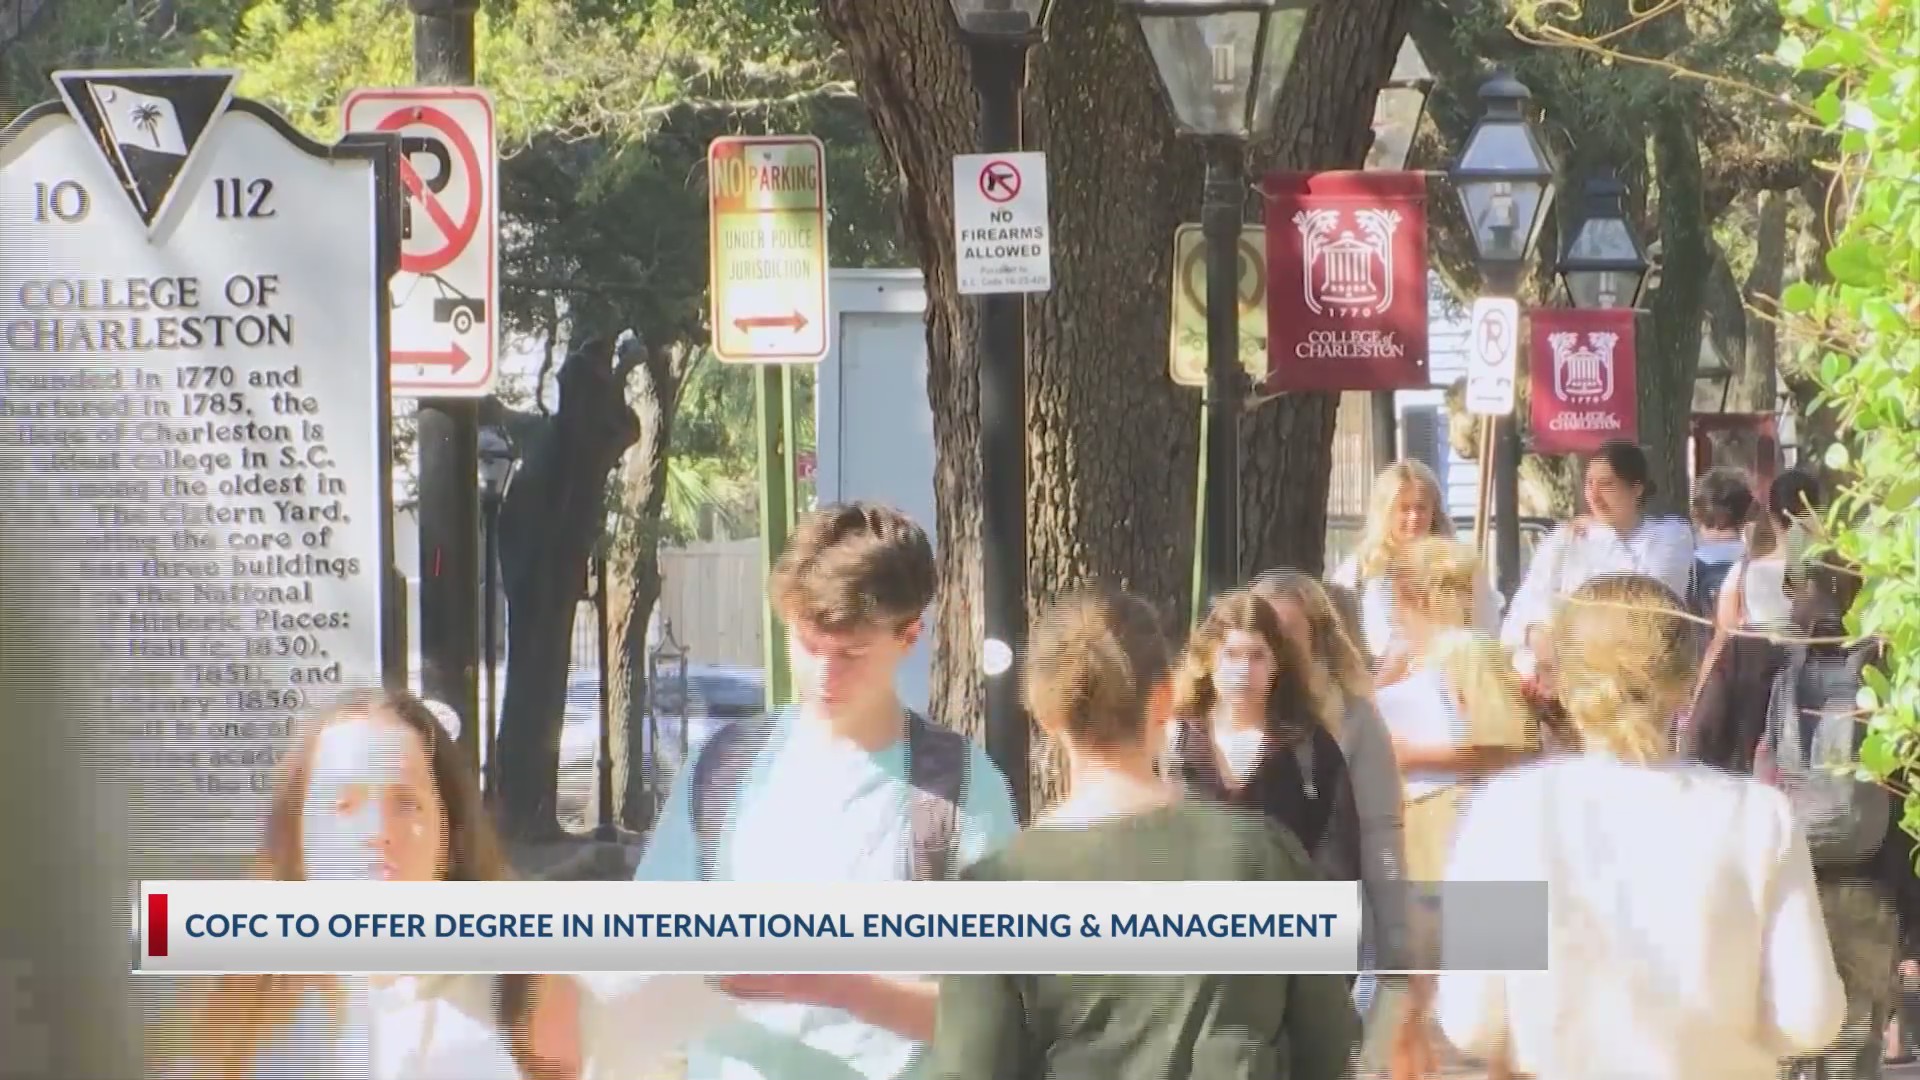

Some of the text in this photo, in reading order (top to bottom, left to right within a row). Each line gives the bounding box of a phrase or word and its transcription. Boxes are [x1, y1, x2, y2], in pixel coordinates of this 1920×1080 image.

[713, 156, 817, 199] NO PARKING
[33, 181, 89, 223] 10
[214, 178, 277, 219] 112
[990, 210, 1013, 223] NO
[725, 228, 812, 249] UNDER POLICE
[961, 226, 1044, 242] FIREARMS
[965, 244, 1041, 259] ALLOWED
[728, 260, 811, 280] JURISDICTION
[19, 275, 279, 311] COLLEGE OF
[1328, 307, 1372, 318] 1770
[5, 315, 294, 353] CHARLESTON
[1308, 331, 1397, 347] COLLEGE of
[1295, 342, 1405, 358] CHARLESTON
[135, 368, 162, 390] in
[176, 365, 234, 390] 1770
[248, 366, 302, 388] and
[0, 396, 132, 418] hartered
[143, 397, 171, 418] in
[272, 392, 319, 415] the
[135, 421, 292, 444] Charleston
[301, 419, 325, 443] is
[1549, 419, 1621, 431] CHARLESTON
[241, 447, 269, 469] in
[279, 445, 336, 470] S.C.
[160, 475, 207, 498] the
[219, 473, 305, 496] oldest
[317, 473, 346, 495] in
[228, 531, 291, 550] core
[301, 526, 333, 549] of
[231, 553, 360, 579] buildings
[192, 581, 314, 604] National
[255, 609, 350, 631] Places:
[289, 662, 344, 684] and
